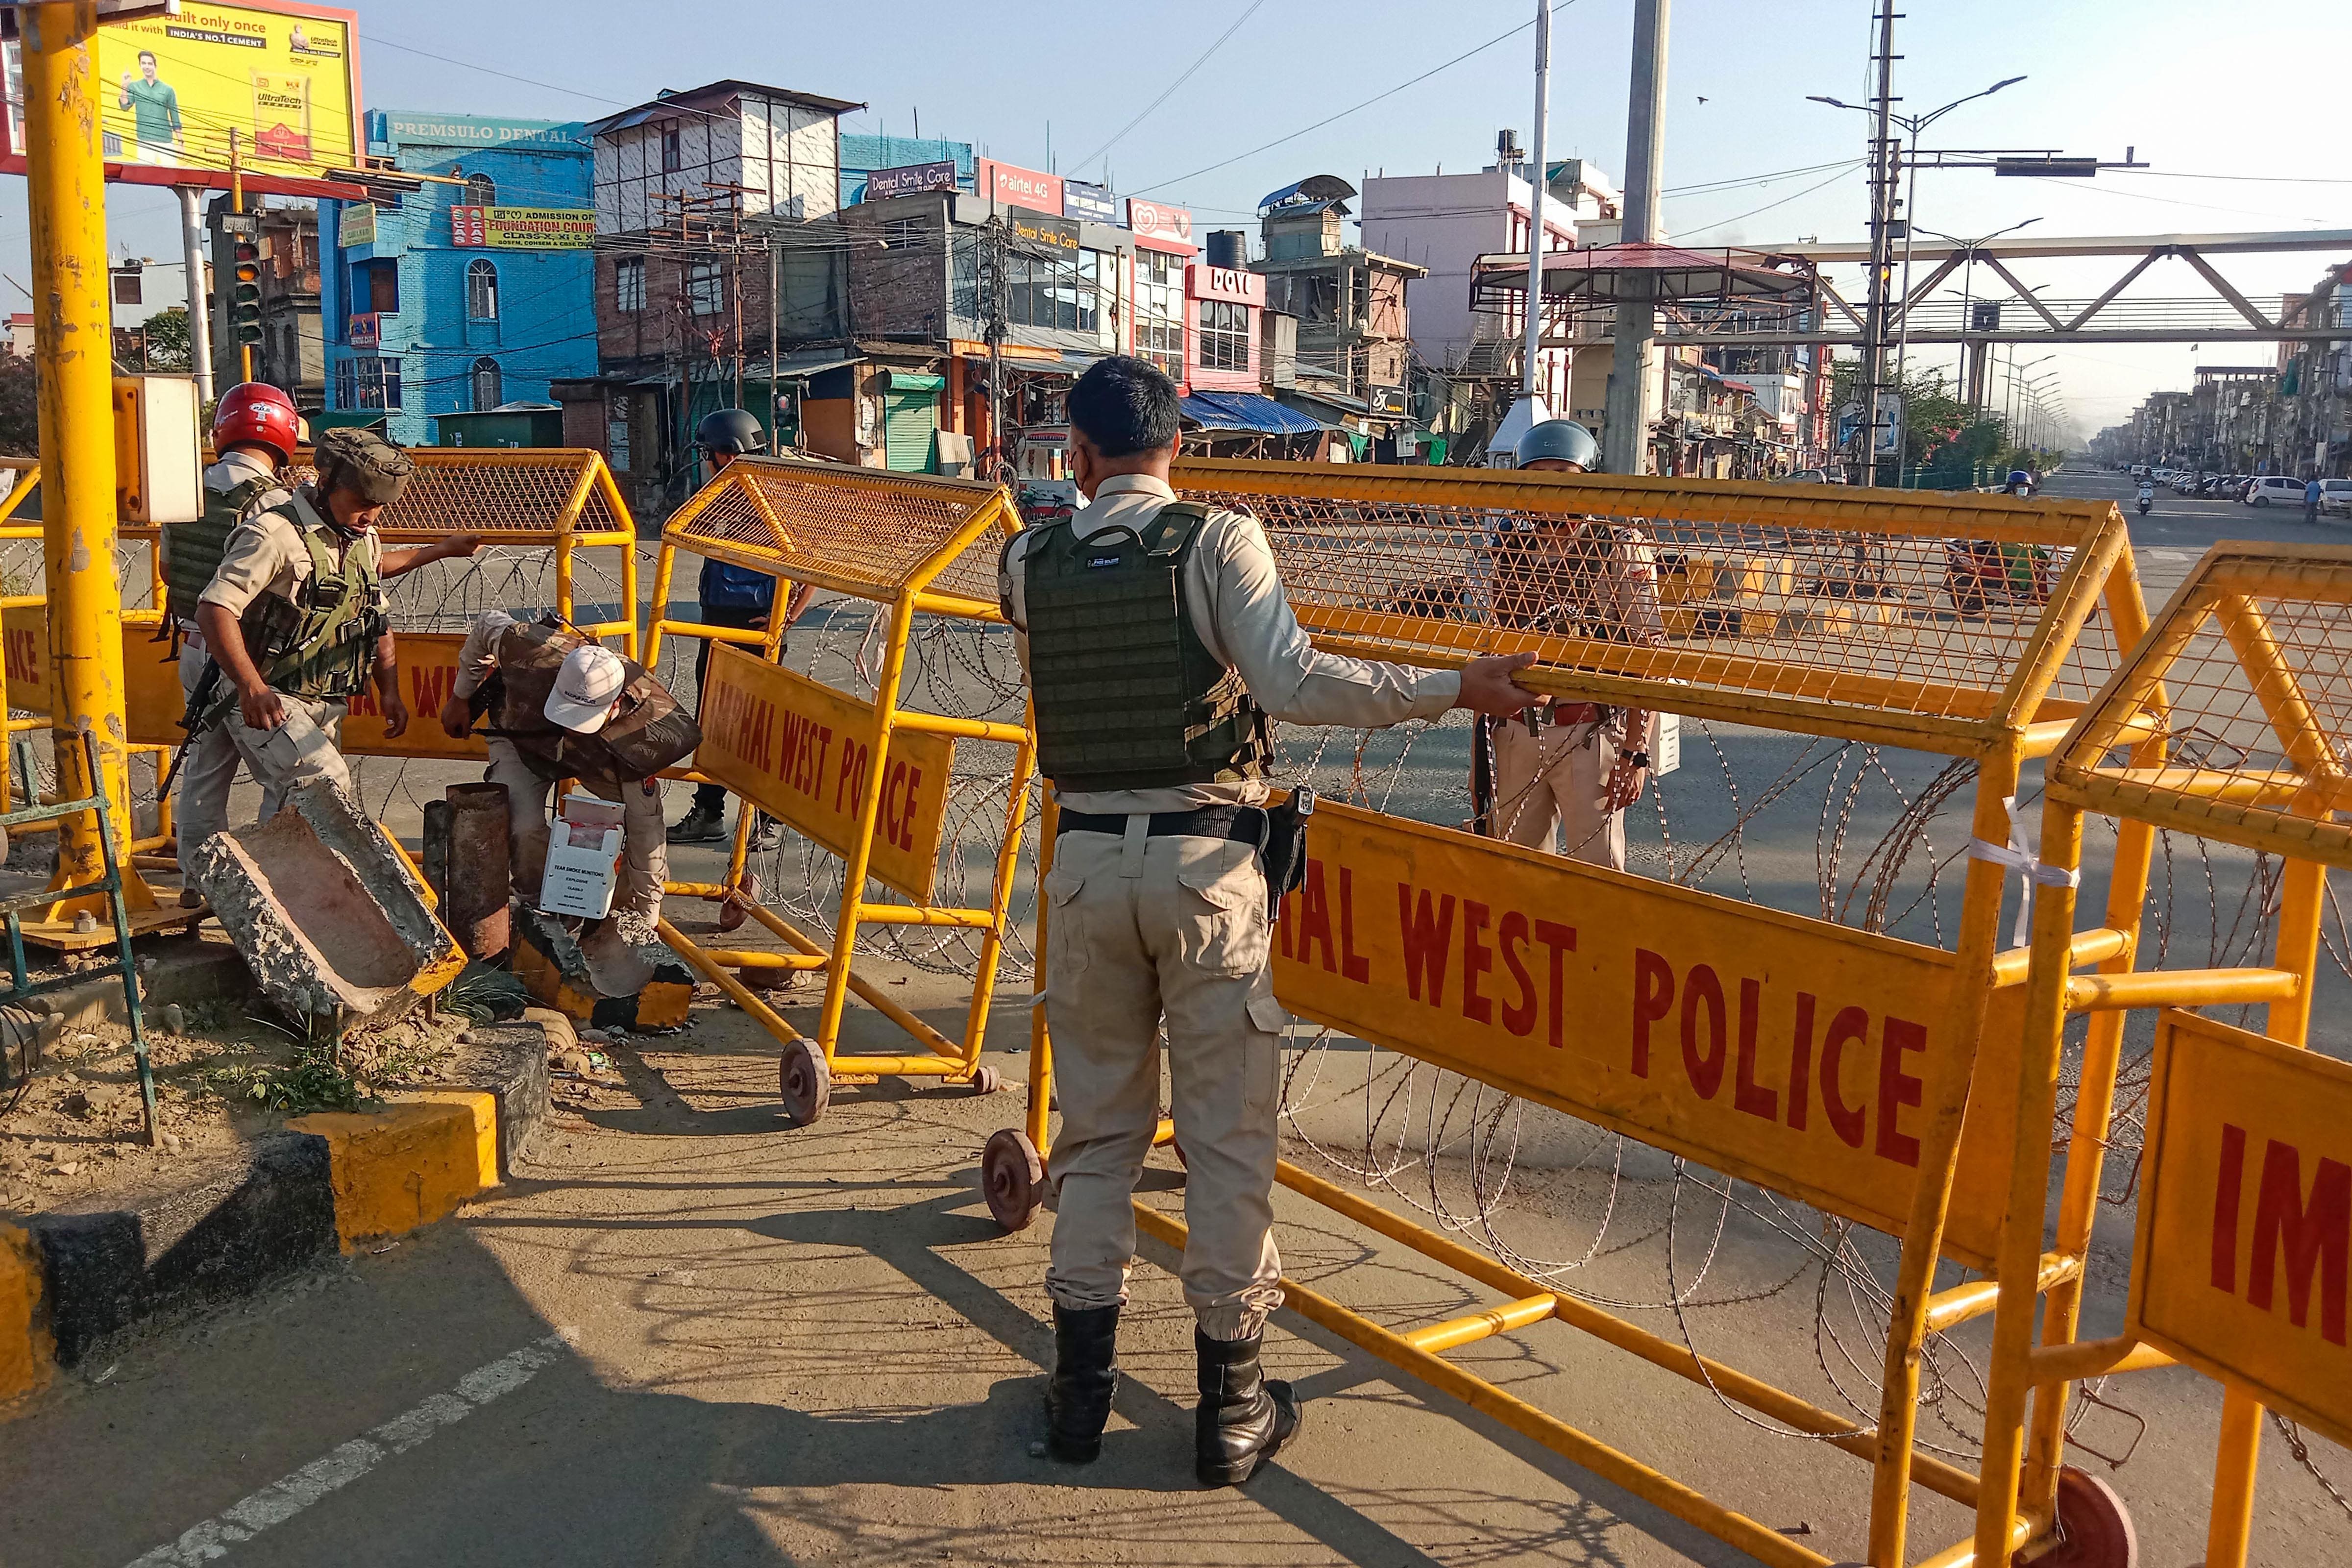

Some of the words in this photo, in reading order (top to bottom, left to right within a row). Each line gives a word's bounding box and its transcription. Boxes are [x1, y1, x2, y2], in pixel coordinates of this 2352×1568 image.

[140, 25, 163, 35] with
[201, 16, 230, 32] only
[234, 21, 266, 33] once
[170, 30, 203, 40] INDIA'S
[205, 34, 226, 43] NO.1
[227, 37, 262, 47] CEMENT
[258, 93, 301, 104] UltraTech
[392, 122, 494, 140] PREMSULO
[499, 127, 569, 144] DENTAL
[872, 173, 899, 191] Dental
[901, 171, 924, 187] Smile
[927, 169, 951, 184] Care
[1008, 175, 1032, 195] airtel
[1034, 183, 1048, 198] 4G
[525, 210, 579, 220] ADMISSION
[490, 220, 560, 233] FOUNDATION
[1015, 221, 1037, 240] Dental
[1040, 227, 1057, 245] Smile
[1059, 232, 1078, 250] Care
[779, 709, 833, 802] WEST
[834, 736, 922, 853] POICE
[1397, 882, 1577, 1049] WEST
[1630, 947, 1927, 1169] POLICE
